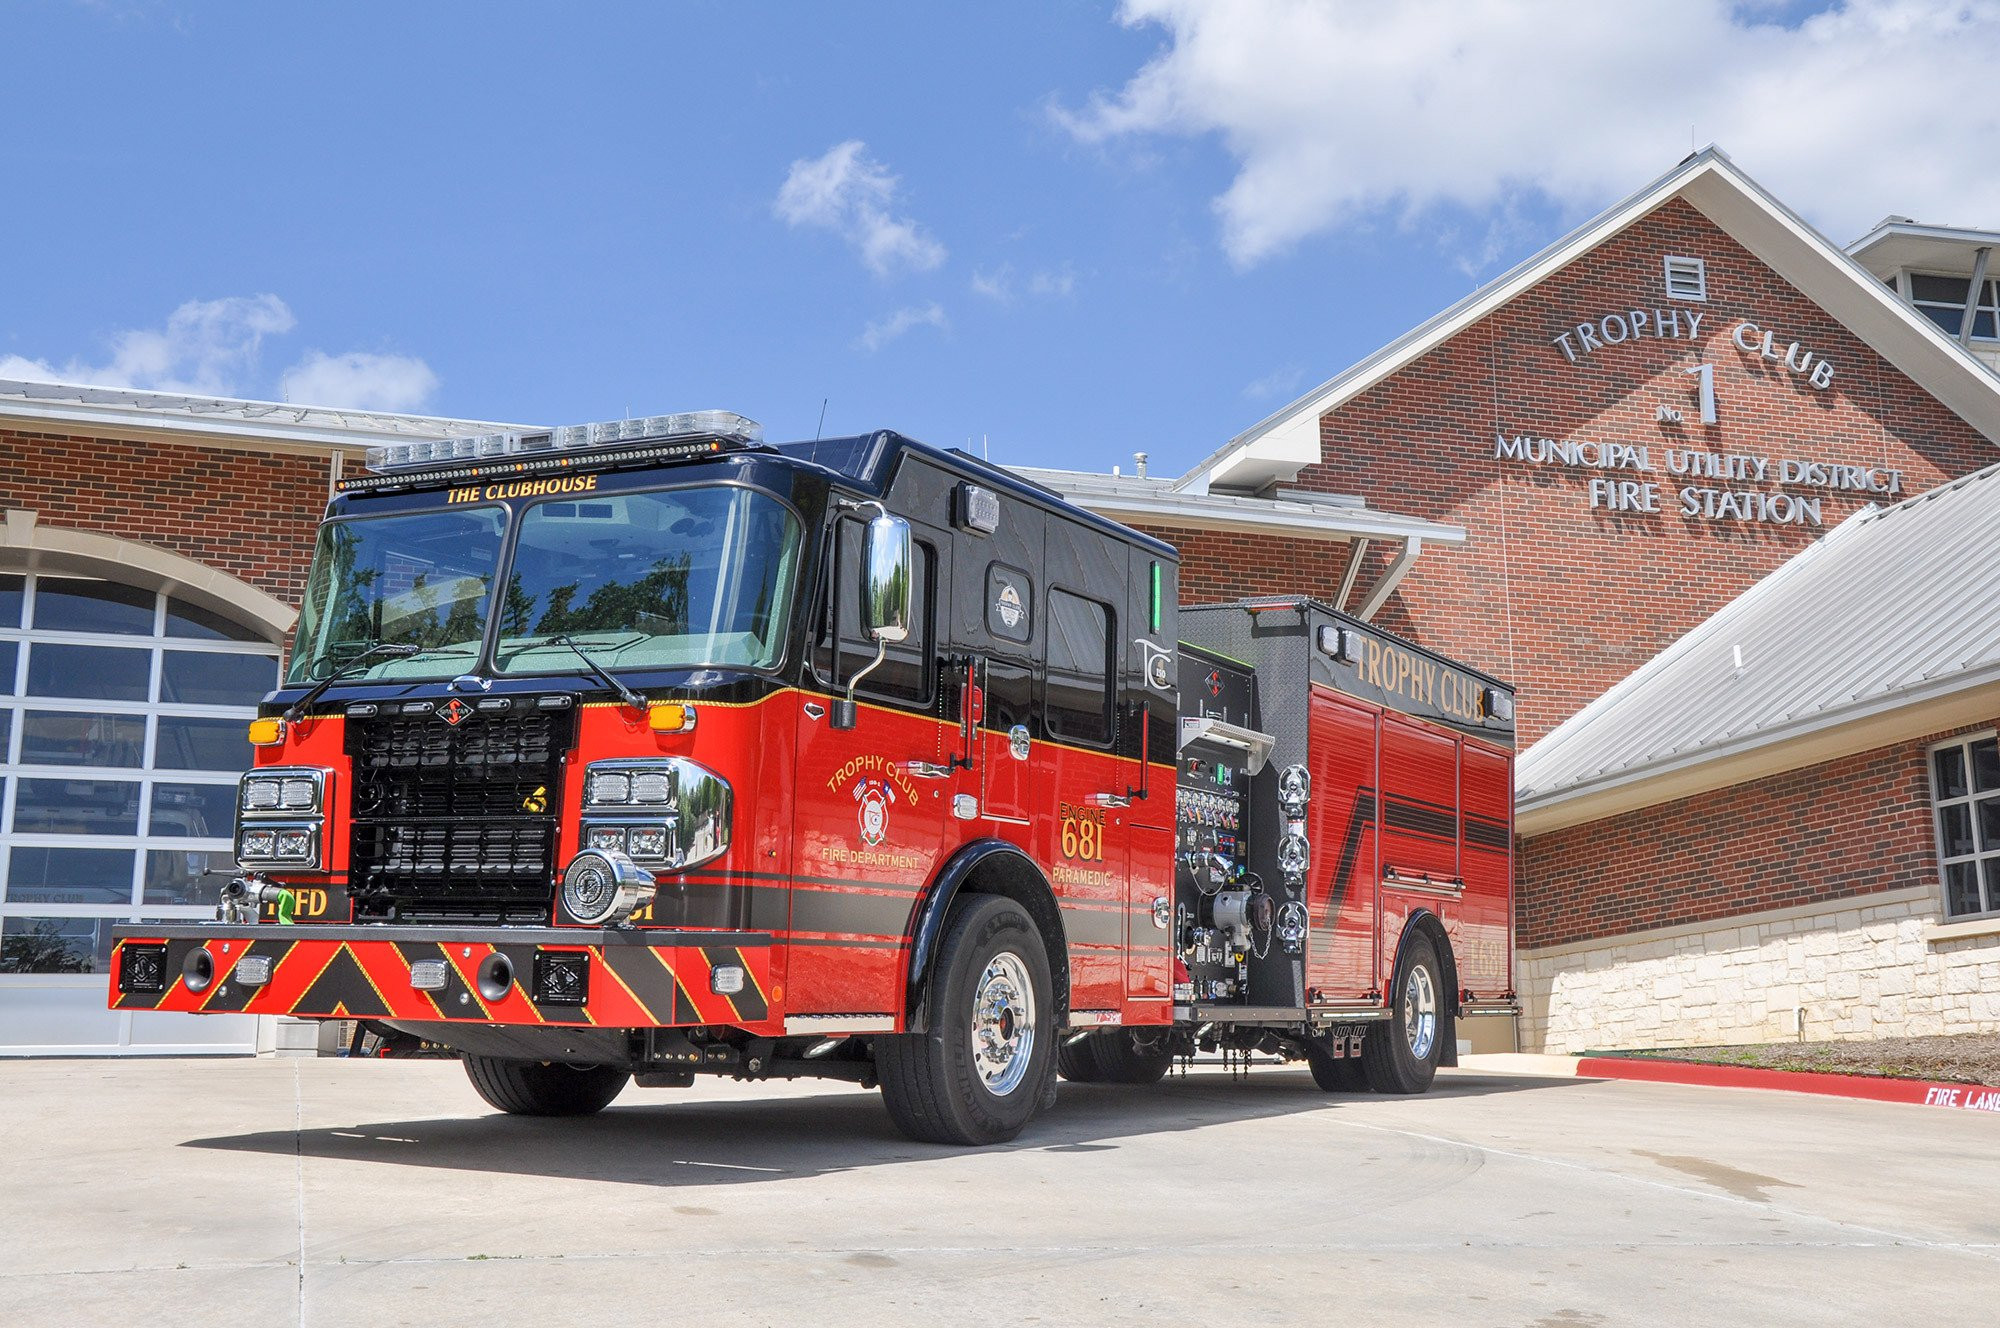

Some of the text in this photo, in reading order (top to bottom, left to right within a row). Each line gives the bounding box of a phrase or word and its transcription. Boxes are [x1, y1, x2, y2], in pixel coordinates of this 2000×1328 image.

[1552, 309, 1834, 391] TROPHY CLUB
[1680, 363, 1716, 425] 1
[1493, 434, 1903, 494] MUNICIPAL UTILITY DISTRICT
[448, 475, 598, 504] THE CLUBHOUSE
[1588, 479, 1822, 527] FIRE STATION
[1358, 636, 1485, 723] TROPHY CLUB
[826, 754, 919, 807] TROPHY CLUB
[1060, 801, 1106, 828] ENGINE
[822, 847, 919, 869] FIRE DEPARTMENT
[1061, 817, 1103, 862] 681
[1052, 866, 1112, 887] PARAMEDIC
[1925, 1087, 1961, 1107] FIRE
